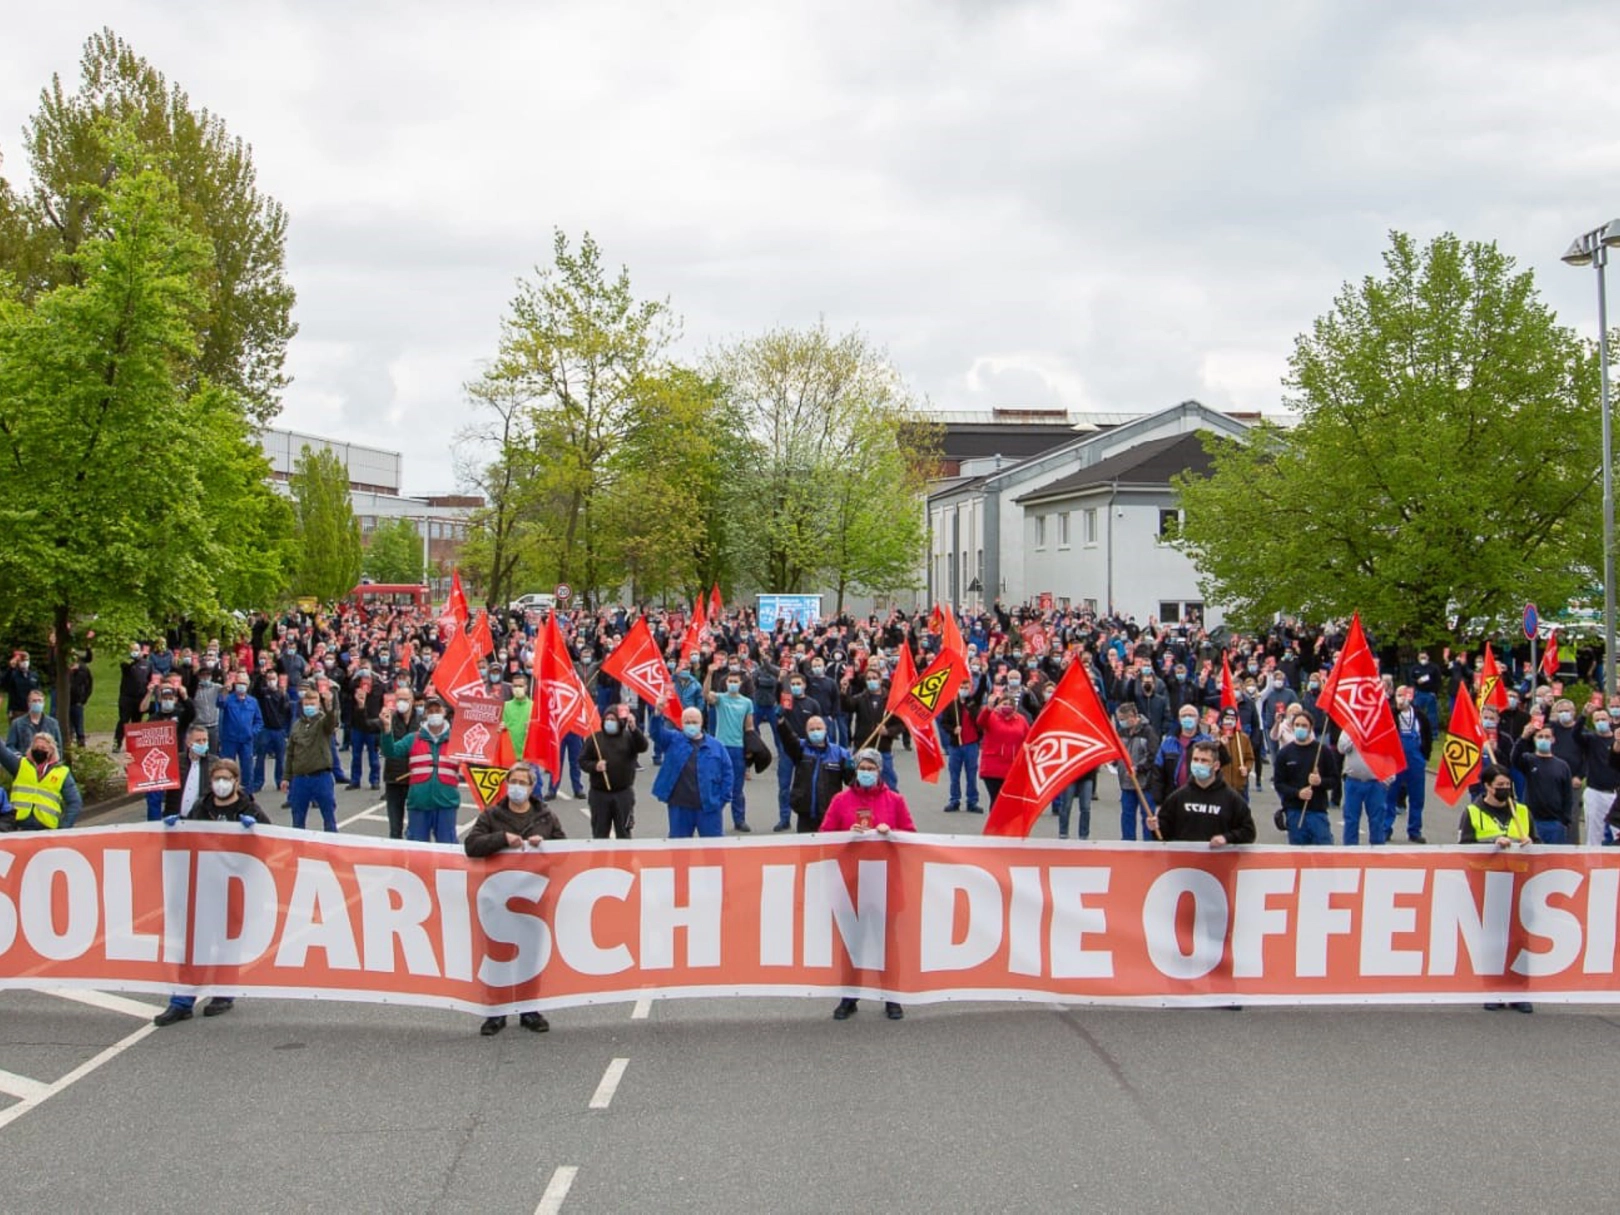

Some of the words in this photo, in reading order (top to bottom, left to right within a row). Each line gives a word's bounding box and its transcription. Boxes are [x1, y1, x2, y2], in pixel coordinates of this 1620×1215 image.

[0, 847, 721, 988] OLIDARISCH
[759, 859, 888, 973] IN
[920, 863, 1114, 978] DIE
[1142, 867, 1620, 980] OFFENSI
